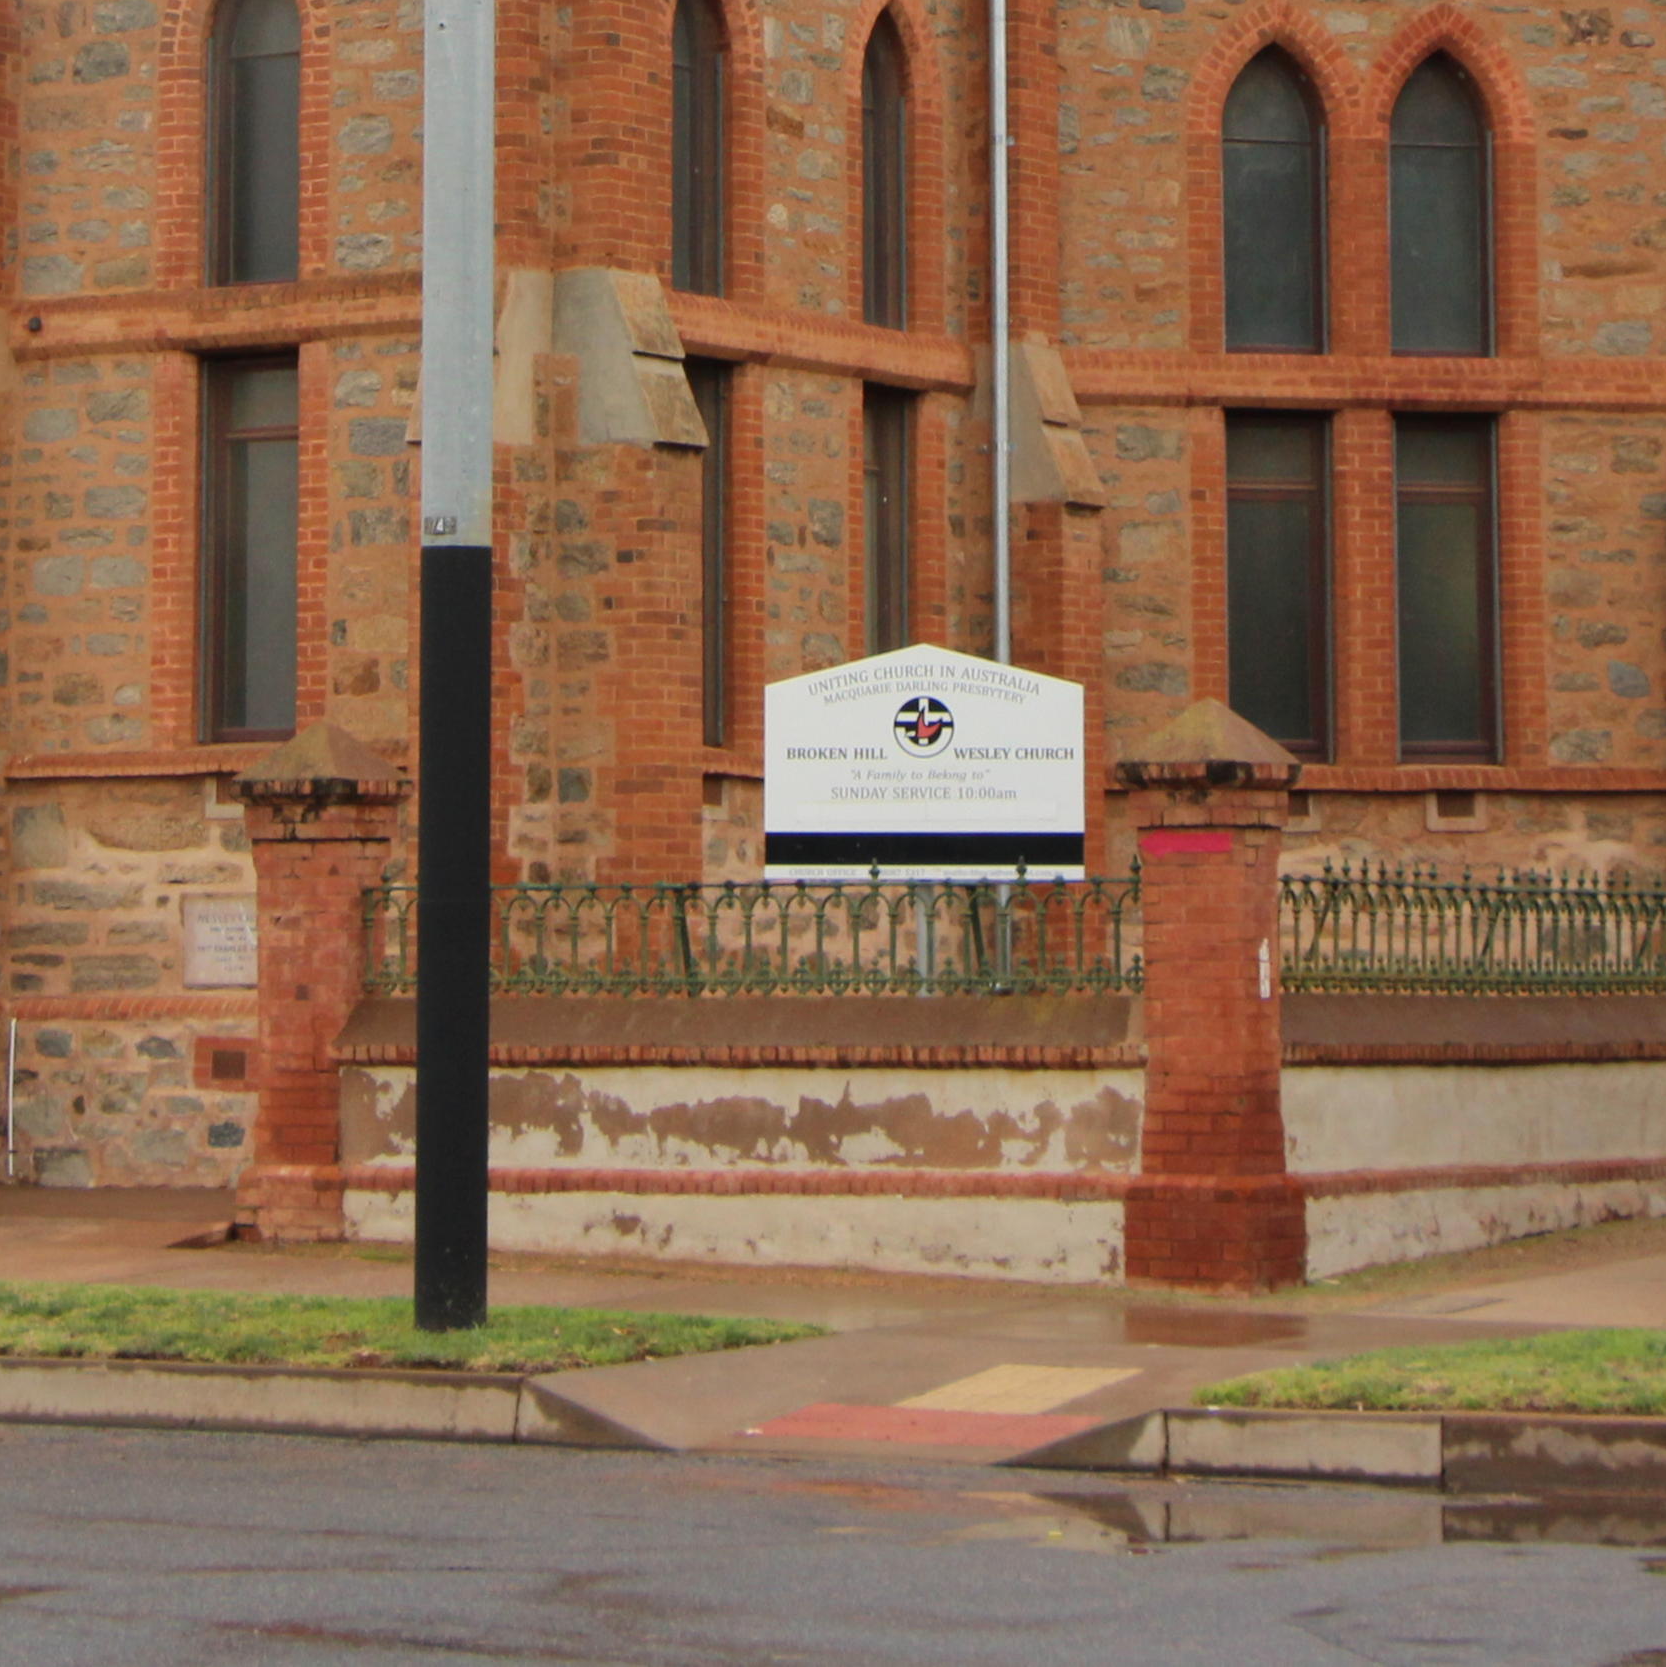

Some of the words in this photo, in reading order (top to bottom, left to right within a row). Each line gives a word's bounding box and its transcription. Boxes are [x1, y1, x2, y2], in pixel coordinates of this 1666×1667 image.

[808, 670, 868, 697] UNITING
[873, 664, 934, 680] CHURCH
[939, 665, 956, 678] IN
[961, 667, 1041, 695] AUSTRALIA
[823, 685, 892, 706] MACQUARIE
[895, 680, 949, 693] DARLING
[952, 682, 1026, 705] PRESBYTERY
[786, 747, 848, 761] BROKEN
[853, 747, 888, 761] HILL
[953, 747, 1011, 761] WESLEY
[1014, 747, 1075, 761] CHURCH
[866, 768, 907, 782] Family
[910, 770, 924, 781] to
[927, 768, 968, 783] Belong
[831, 786, 887, 800] SUNDAY
[892, 786, 952, 800] SERVICE
[957, 787, 1018, 800] 10:00am
